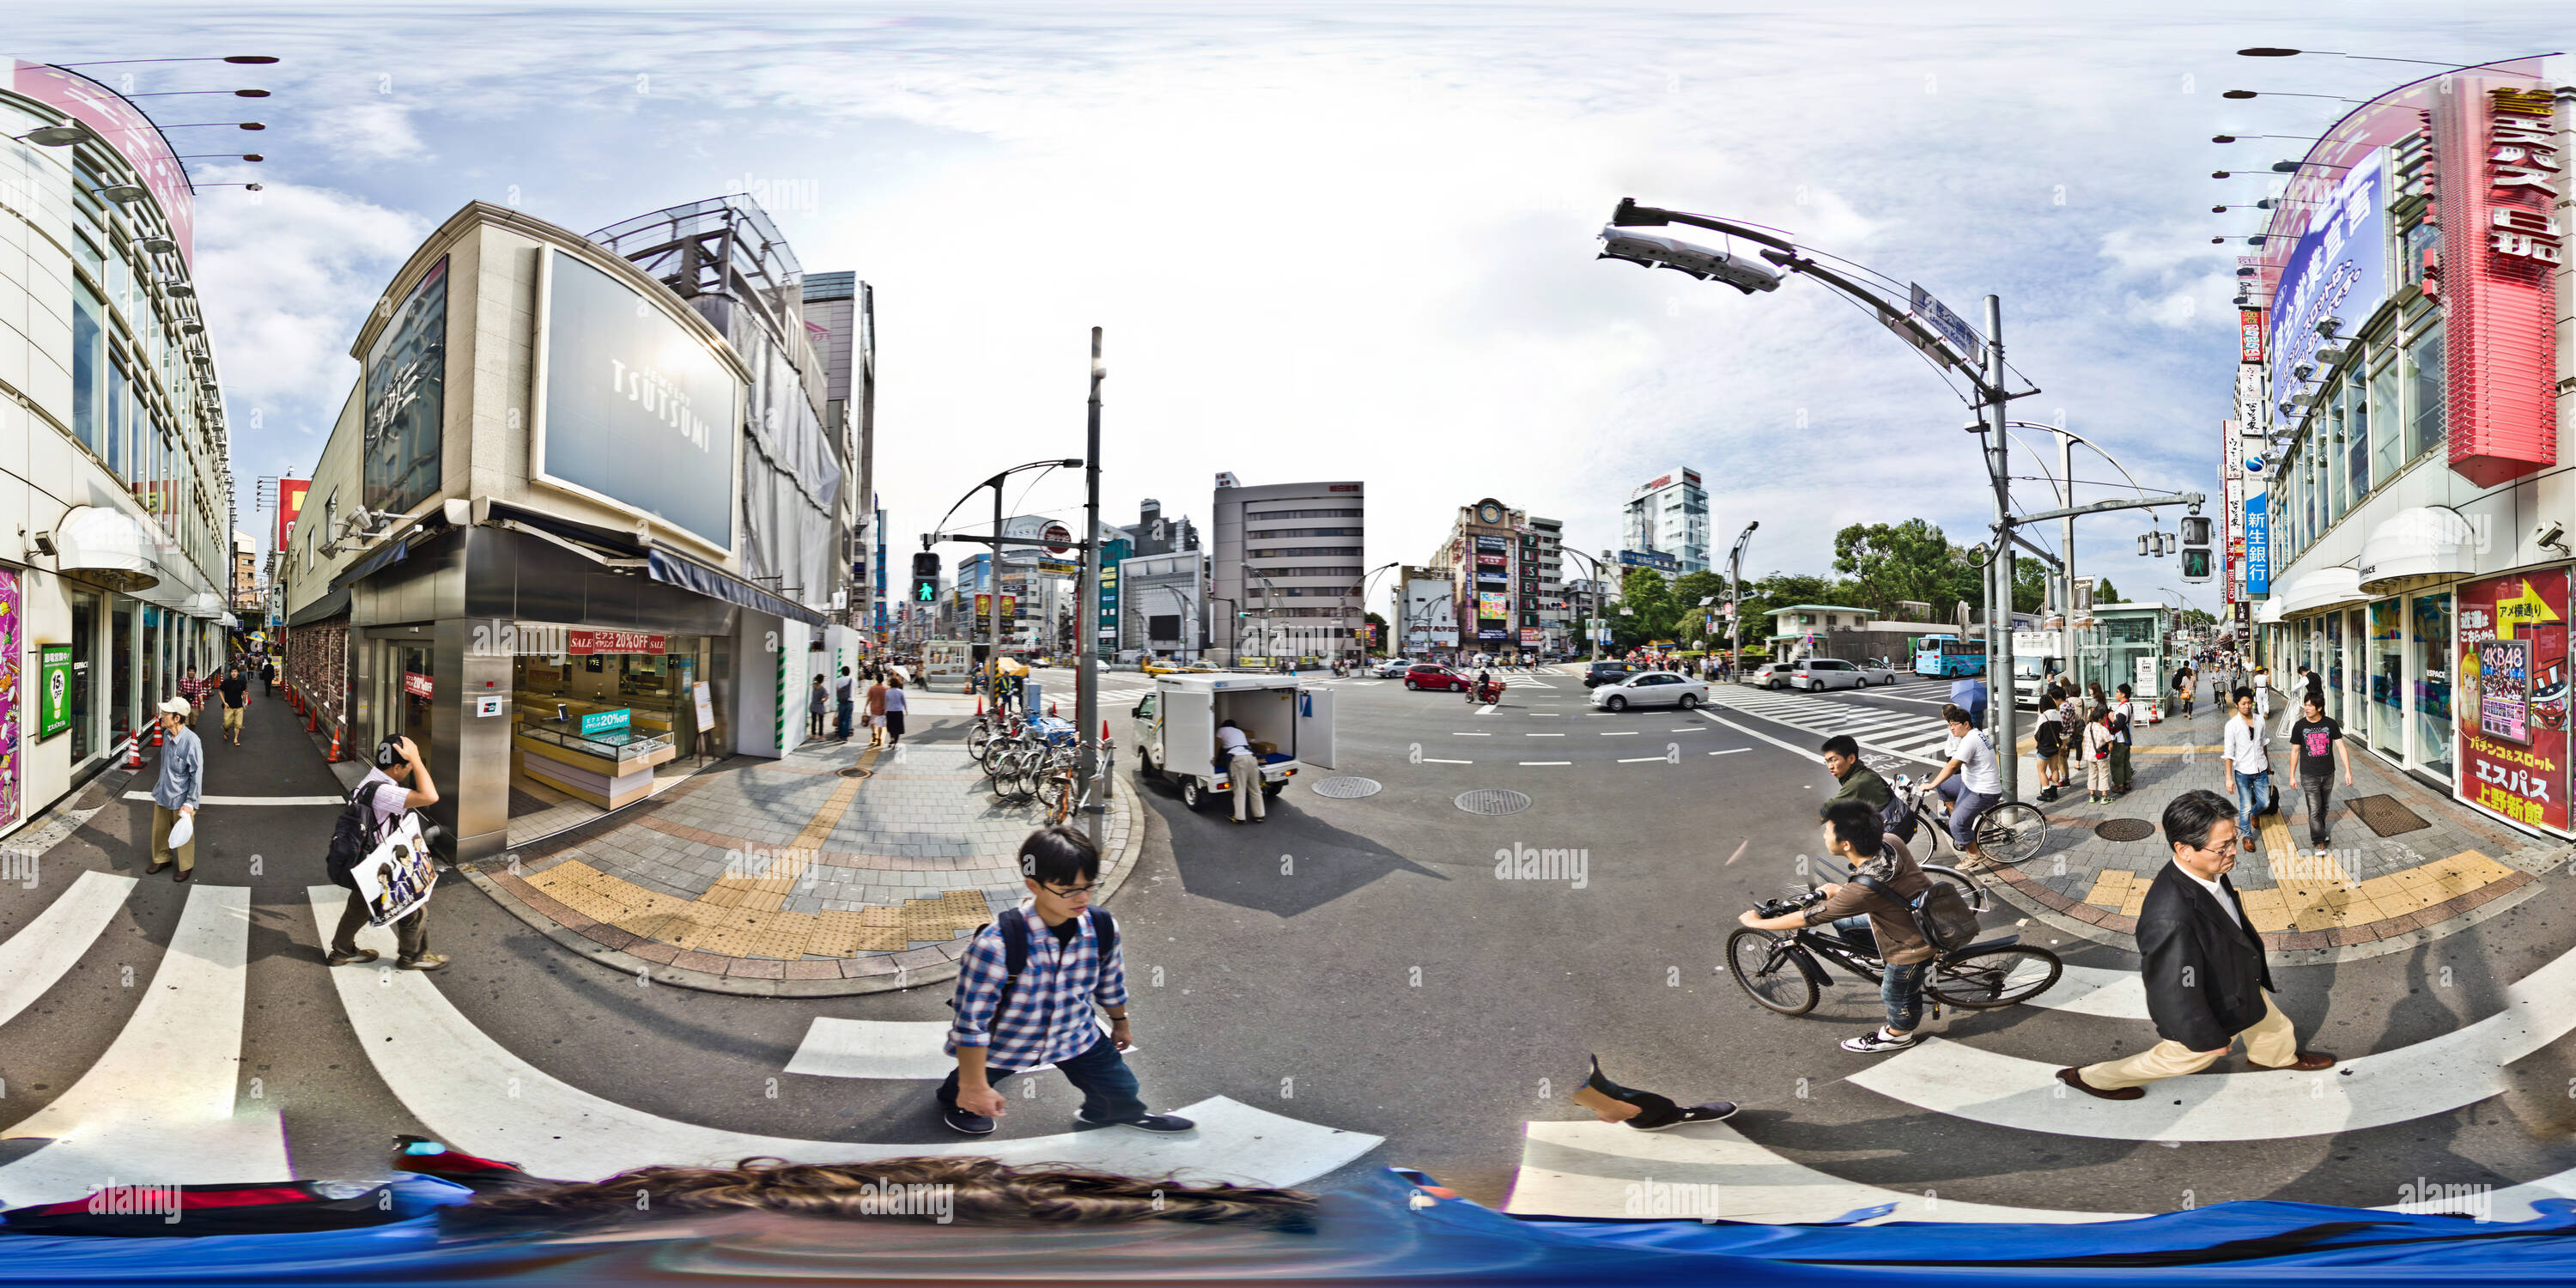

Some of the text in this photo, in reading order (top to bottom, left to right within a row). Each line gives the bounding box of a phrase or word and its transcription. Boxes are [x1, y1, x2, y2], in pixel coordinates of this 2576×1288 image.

[611, 358, 709, 453] TSUTSUMI
[2248, 512, 2267, 581] 新生銀行
[2360, 566, 2375, 577] ESPACE
[2500, 603, 2542, 618] アメ横通り
[2460, 611, 2488, 629] 近道は
[570, 638, 593, 647] SALE
[616, 634, 647, 647] 20%OFF
[2460, 629, 2495, 642] こちらから
[2483, 647, 2523, 667] AKB48
[2427, 670, 2445, 678] ESPACE
[601, 713, 628, 726] 20%OFF
[2470, 736, 2555, 773] パチンコ&スロット
[2476, 759, 2549, 803] エスパス
[2476, 782, 2543, 827] 上野新館
